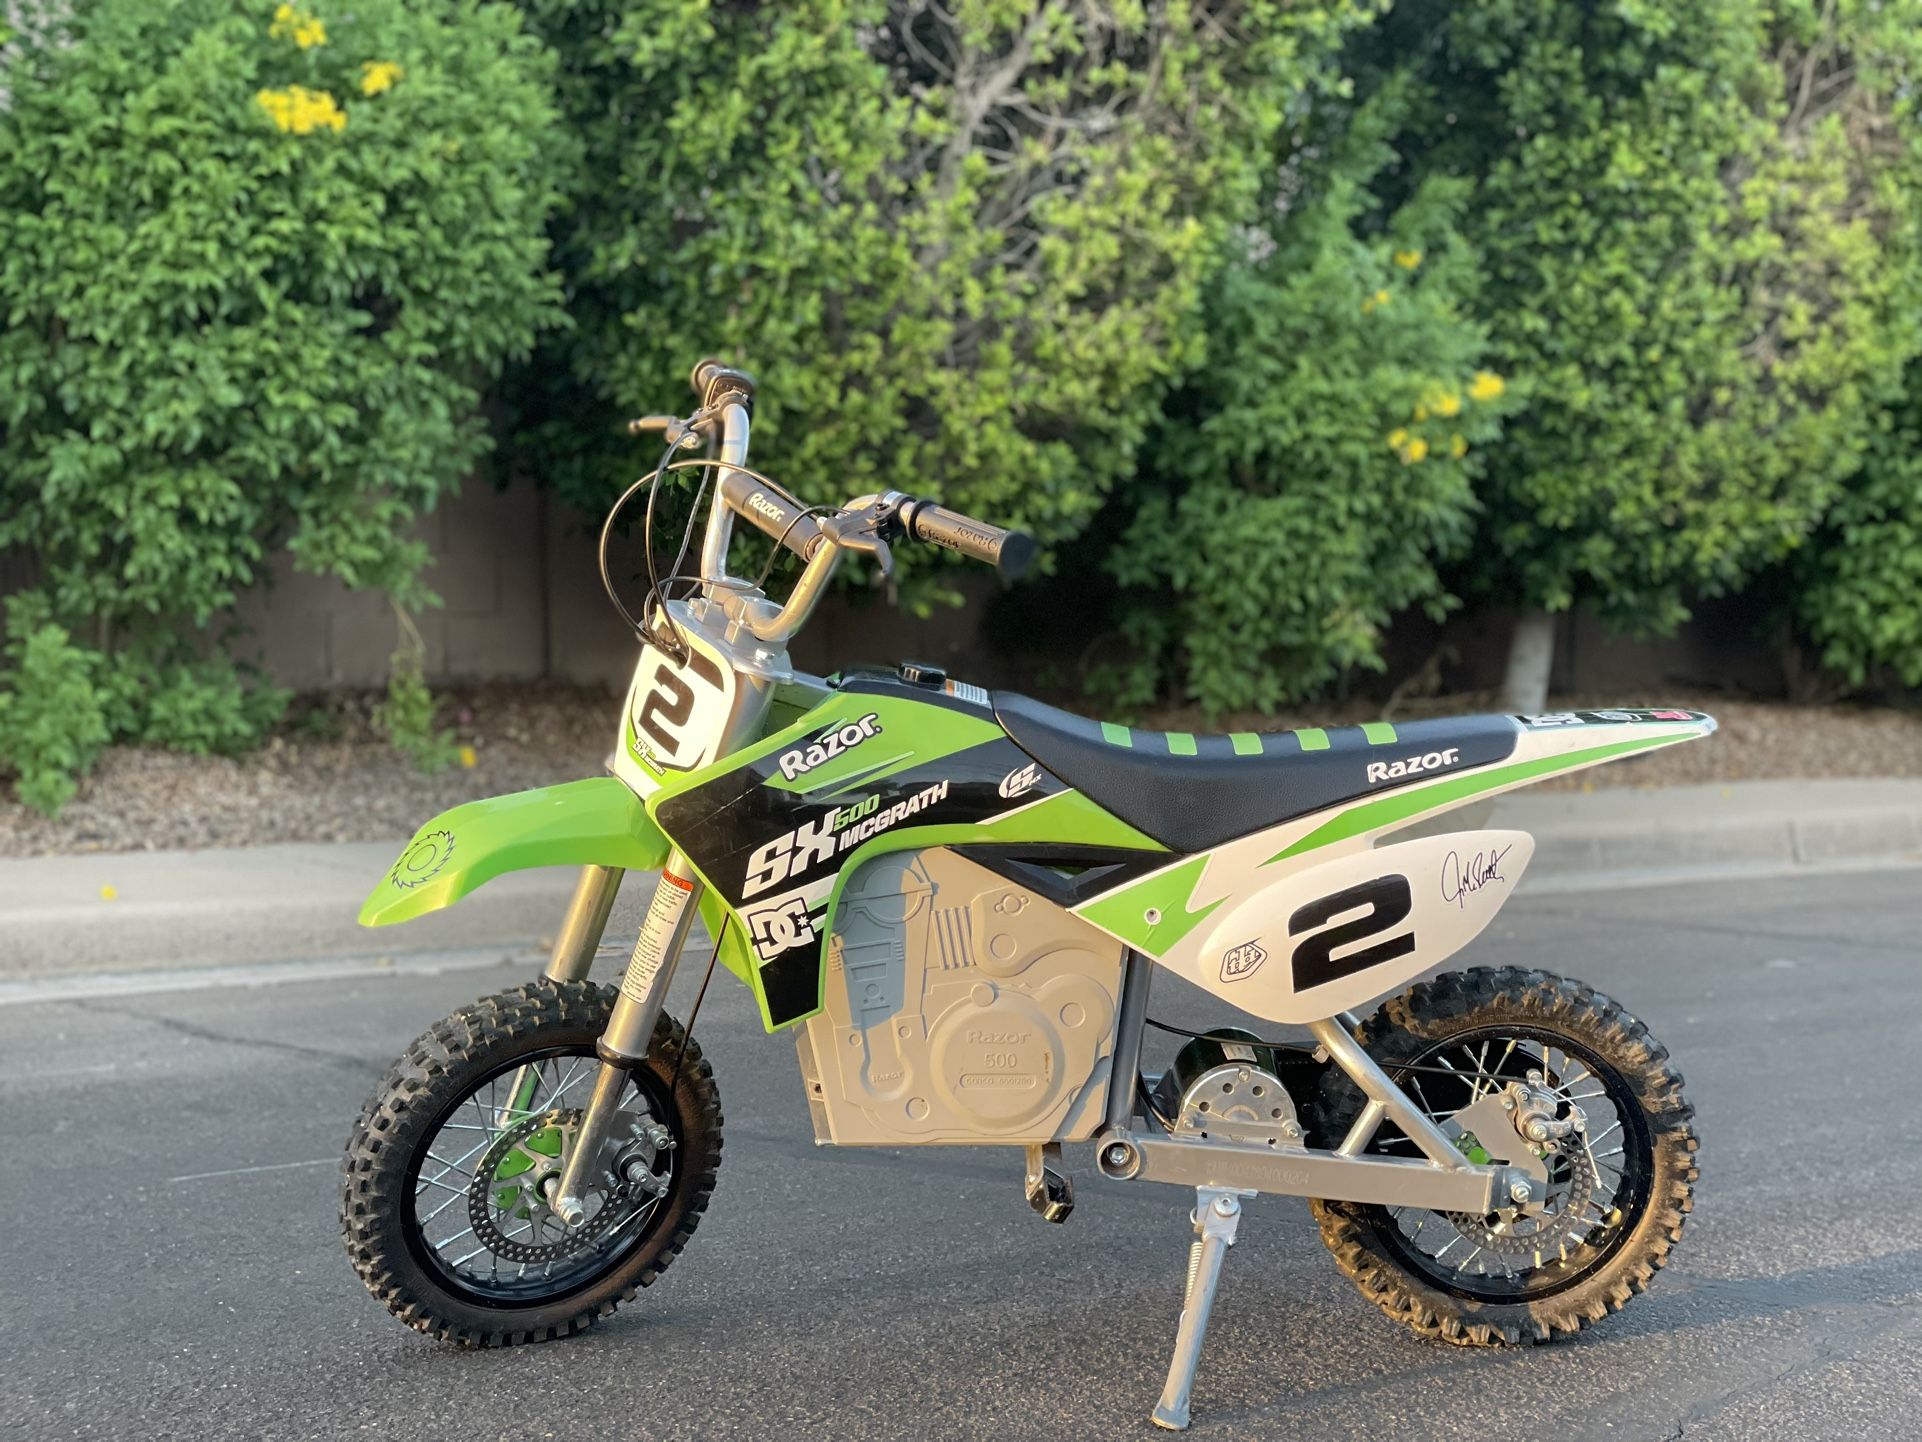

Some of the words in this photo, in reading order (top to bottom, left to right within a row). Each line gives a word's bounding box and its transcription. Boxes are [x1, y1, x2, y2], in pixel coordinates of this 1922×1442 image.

[638, 663, 695, 757] 2
[833, 793, 881, 832] 500
[838, 779, 949, 851] MCGRATH
[742, 805, 841, 899] SX
[750, 897, 815, 960] DC
[1288, 873, 1416, 993] 2
[984, 1053, 1018, 1069] 500
